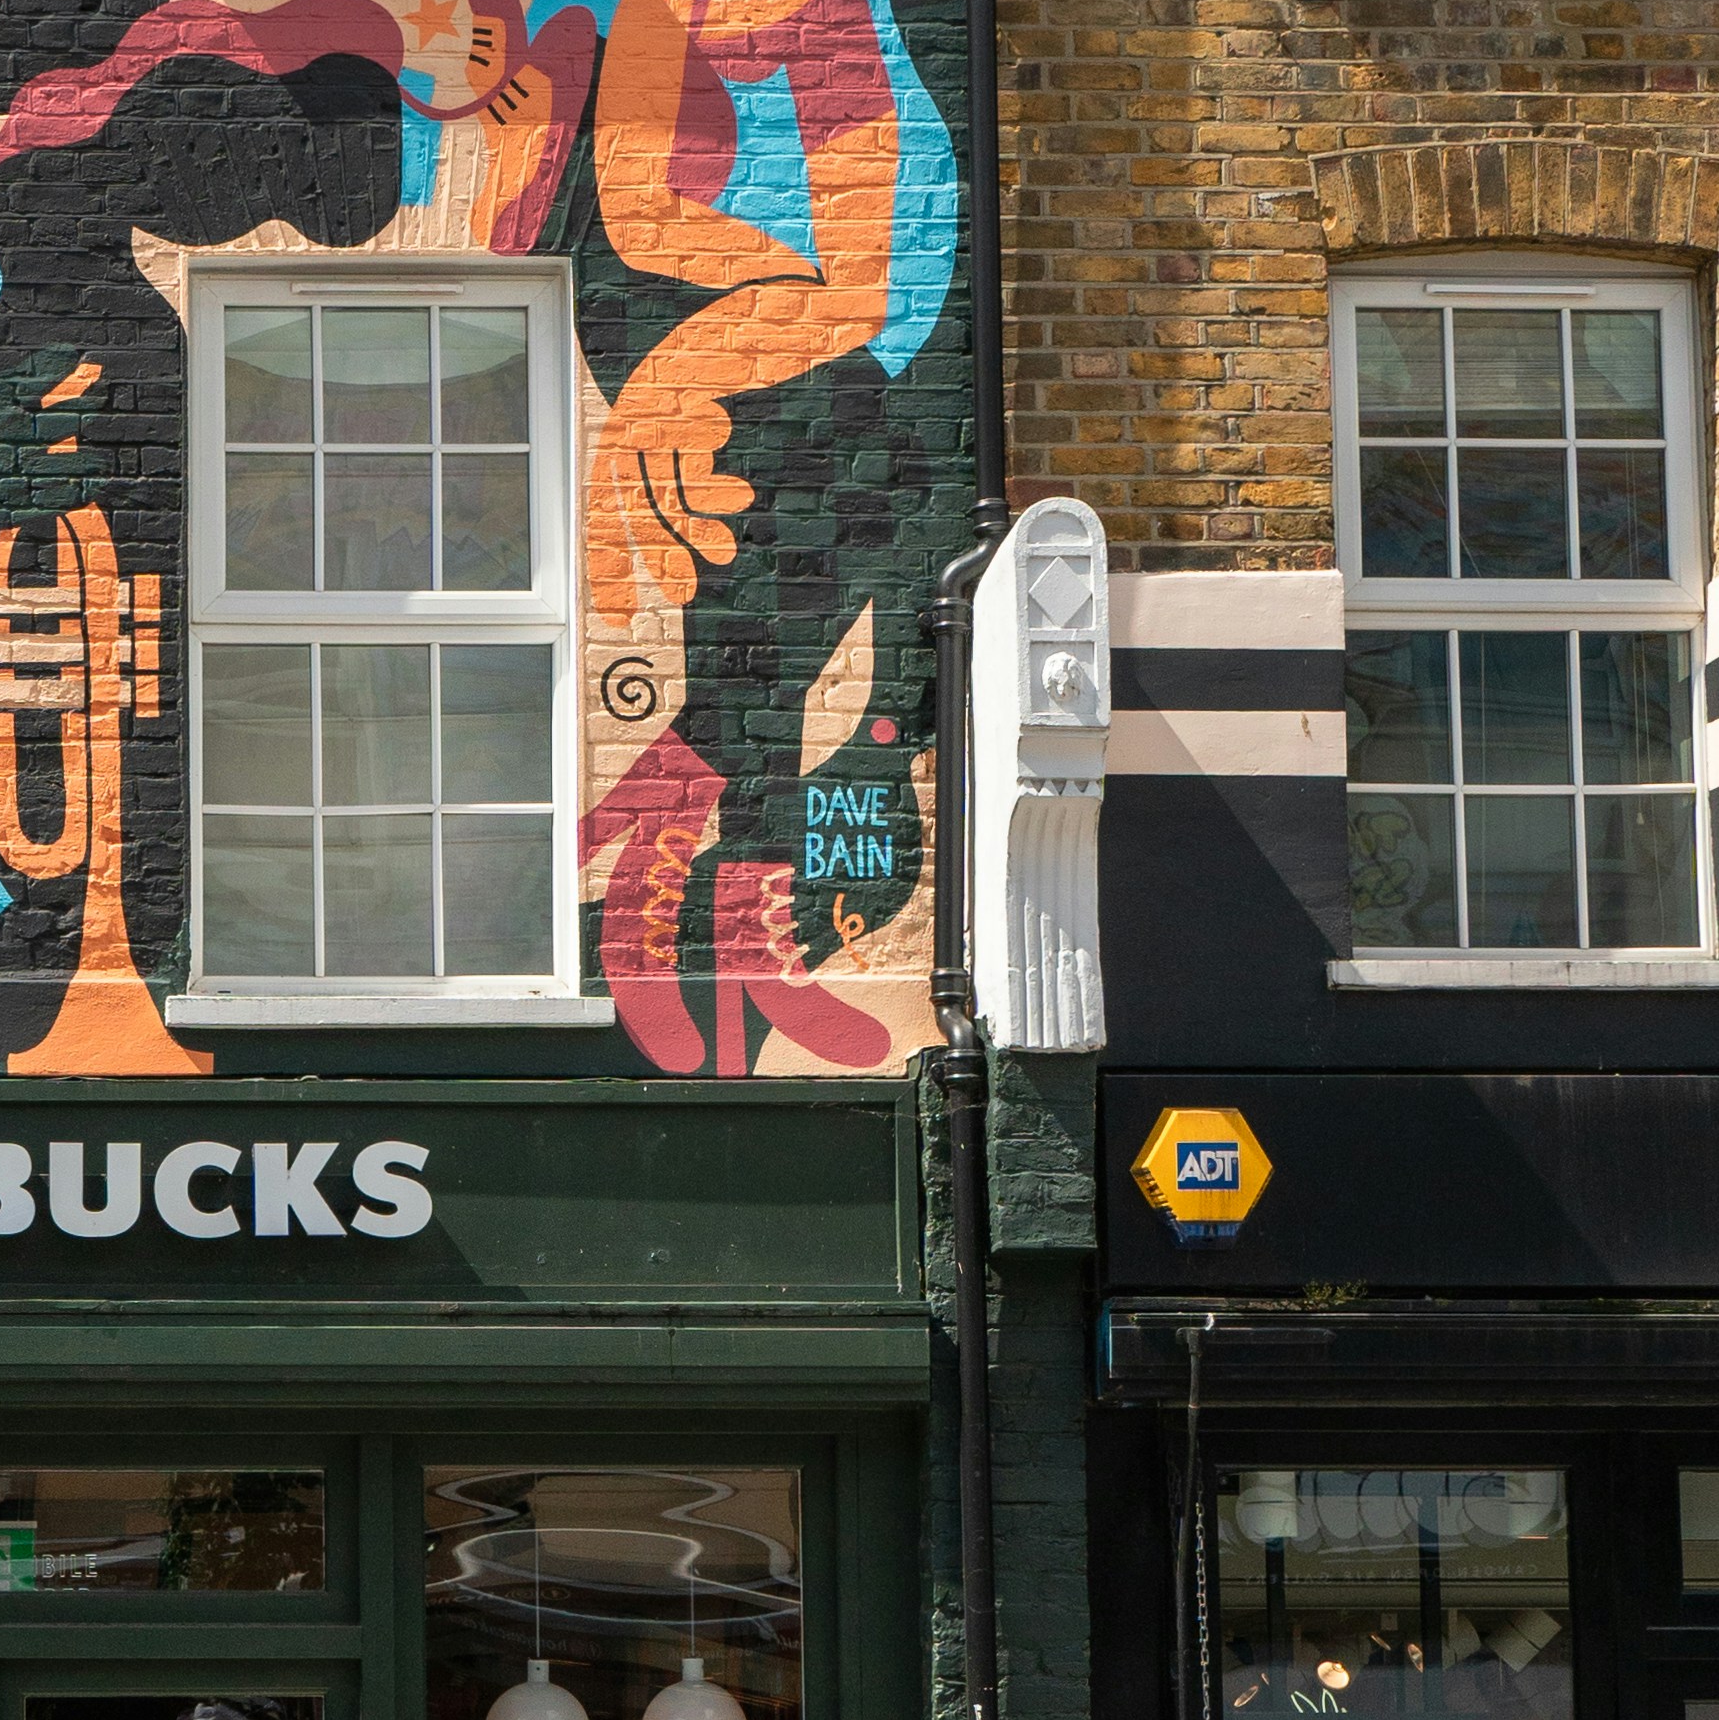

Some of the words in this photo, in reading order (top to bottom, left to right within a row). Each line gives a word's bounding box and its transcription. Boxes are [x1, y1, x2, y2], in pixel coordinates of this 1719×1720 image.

[806, 786, 889, 826] DAVE
[805, 832, 893, 879] BAIN
[1177, 1150, 1238, 1181] ADT
[34, 1554, 98, 1578] BILE
